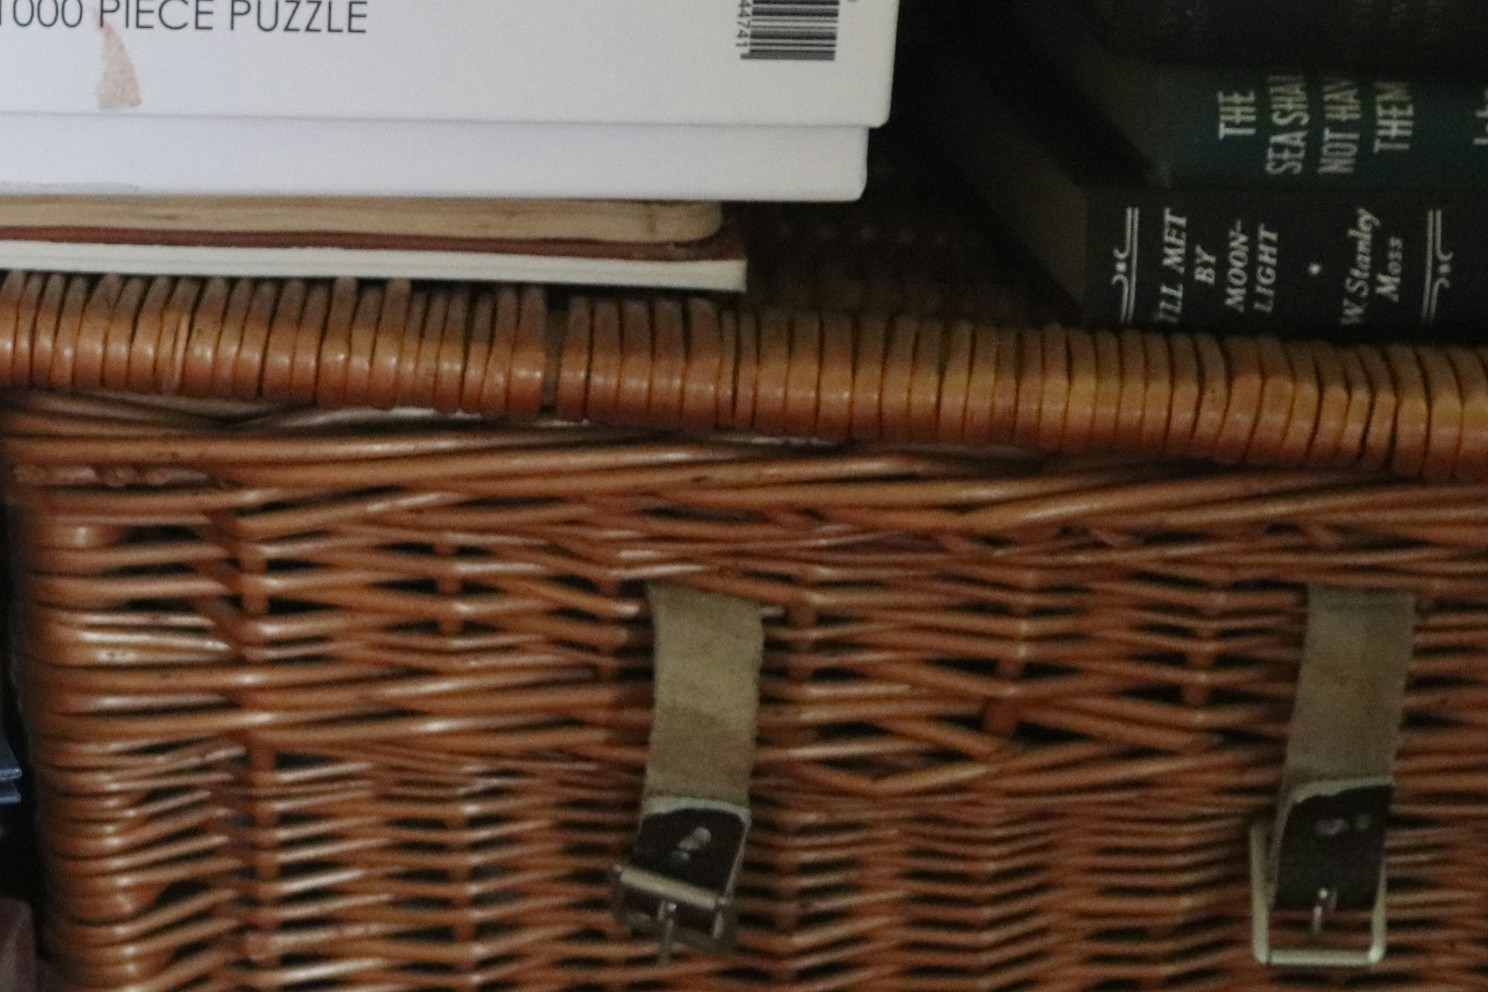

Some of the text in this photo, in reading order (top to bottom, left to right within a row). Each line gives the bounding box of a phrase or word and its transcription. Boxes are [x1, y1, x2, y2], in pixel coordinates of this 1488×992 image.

[99, 0, 214, 30] PIECE
[230, 0, 369, 34] PUZZLE
[1217, 89, 1257, 140] THE
[1265, 130, 1308, 175] SEA
[1316, 126, 1361, 175] NOT
[1162, 207, 1188, 276] MET
[1193, 243, 1217, 286] BY
[1224, 220, 1250, 313] MOON-
[1253, 223, 1279, 314] LIGHT
[1375, 236, 1404, 303] Moss
